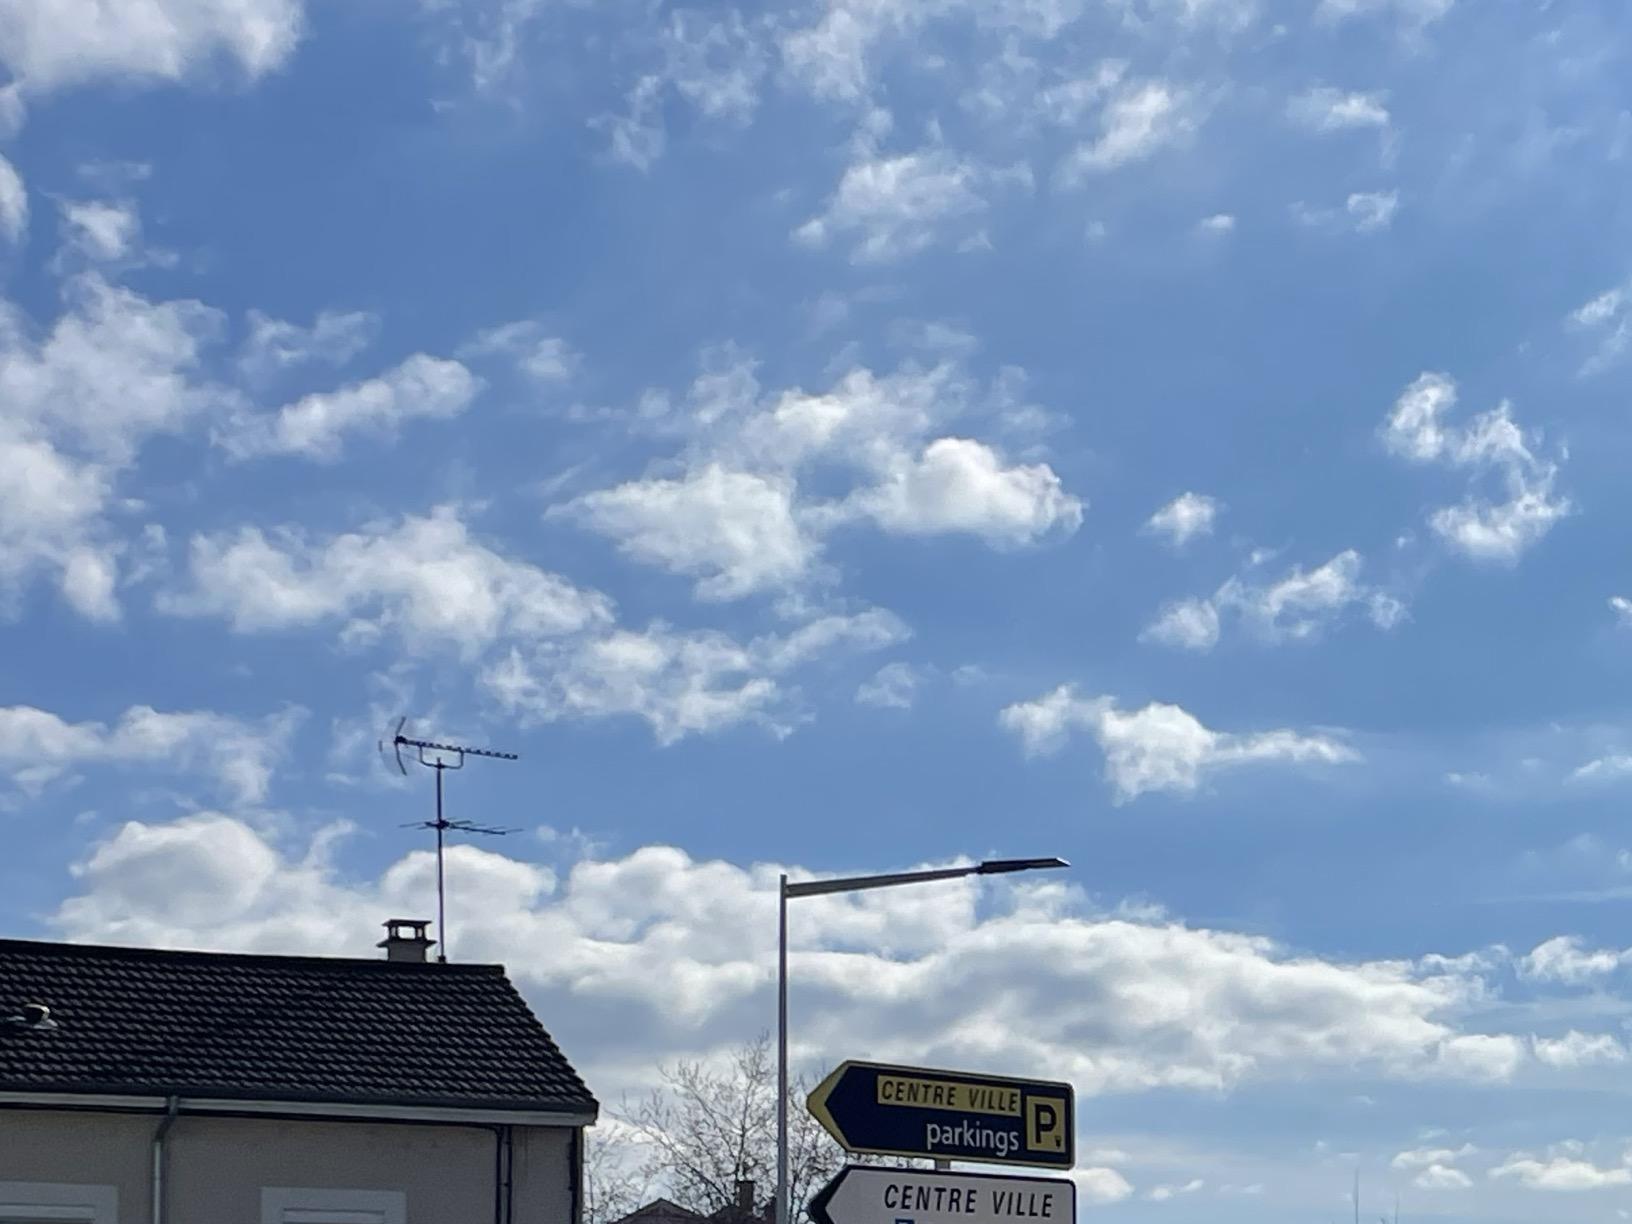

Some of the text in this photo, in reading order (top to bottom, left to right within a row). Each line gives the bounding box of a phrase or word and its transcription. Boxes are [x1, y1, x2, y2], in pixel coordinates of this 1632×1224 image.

[881, 1080, 1019, 1112] CENTRE VILLE
[926, 1120, 1019, 1156] parkings
[1034, 1103, 1057, 1144] P
[884, 1184, 1053, 1218] CENTRE VILLE
